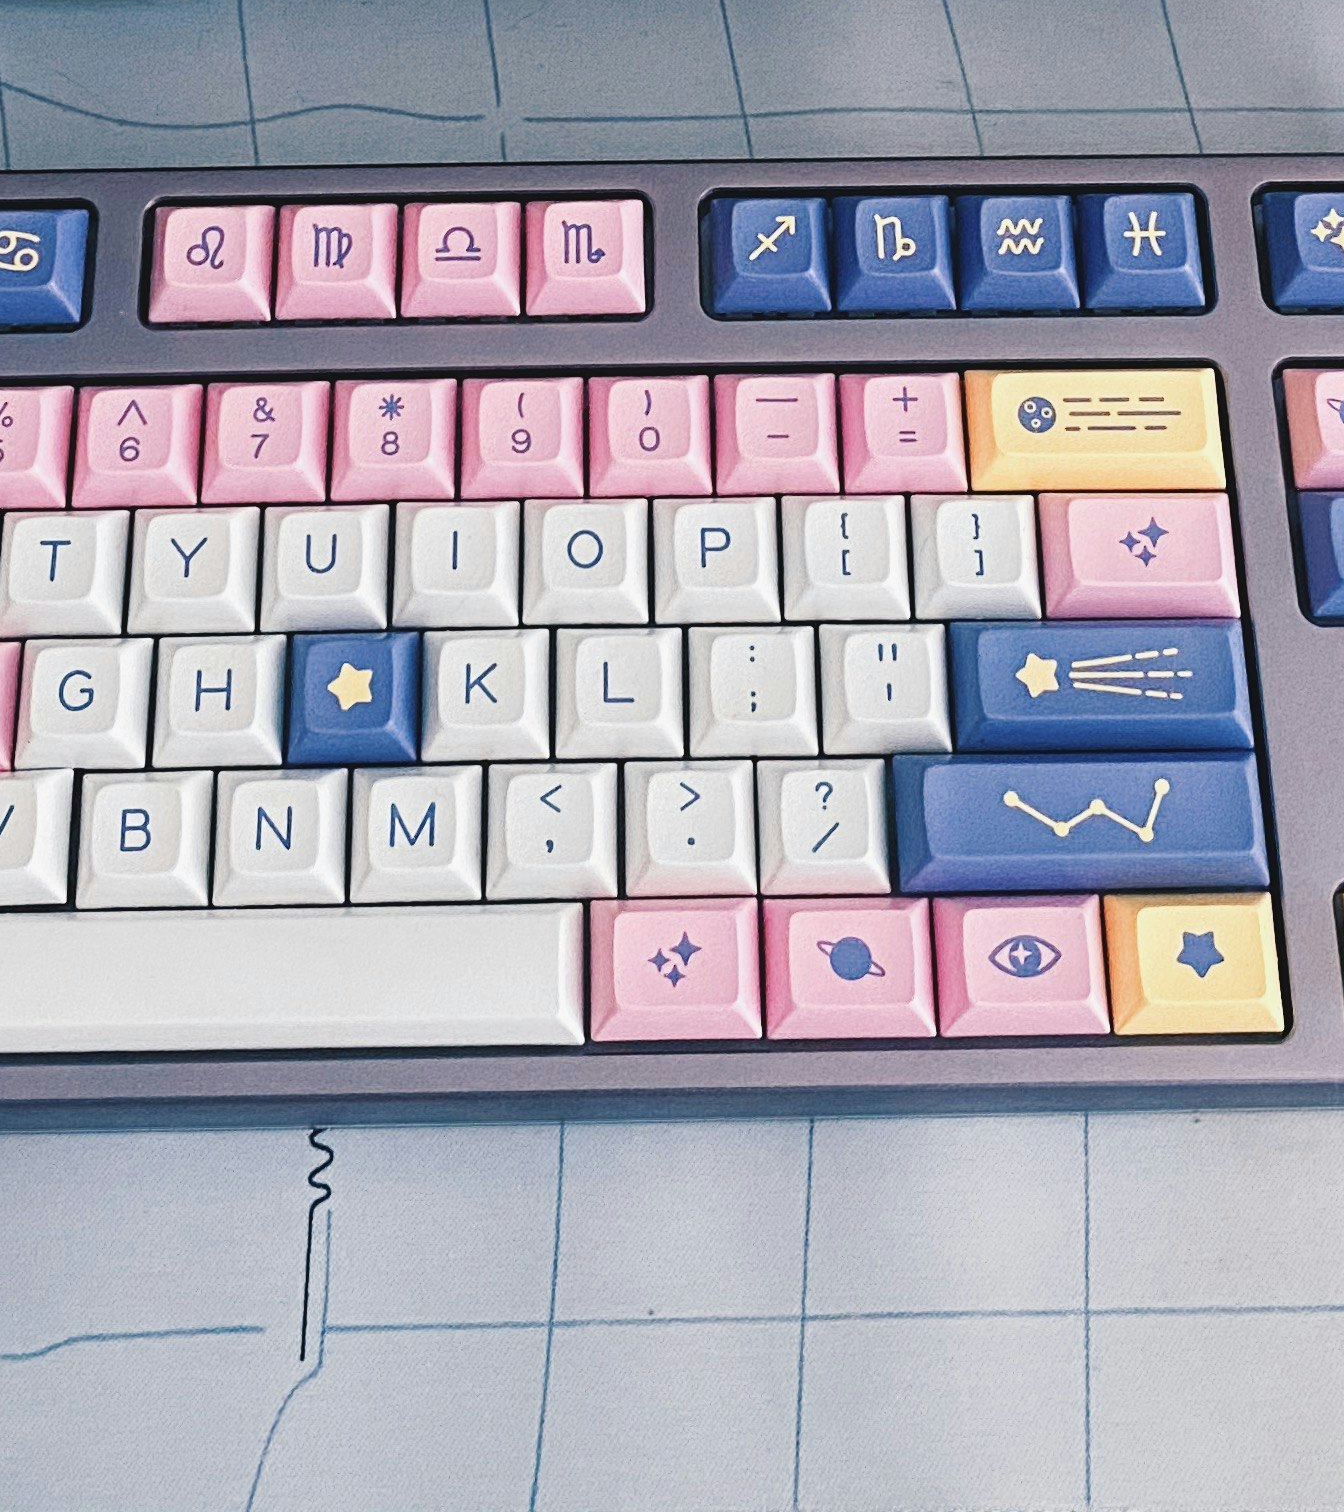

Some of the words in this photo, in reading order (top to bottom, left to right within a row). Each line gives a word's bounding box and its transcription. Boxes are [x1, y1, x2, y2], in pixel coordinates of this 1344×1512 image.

[119, 436, 141, 462] 6
[250, 433, 270, 460] 7
[380, 430, 400, 456] 8
[511, 428, 532, 454] 9
[638, 426, 661, 452] 0
[39, 539, 72, 583] T
[170, 537, 208, 578] Y
[305, 533, 338, 574] U
[452, 530, 458, 571] I
[566, 529, 604, 569] O
[700, 527, 731, 569] P
[58, 669, 95, 712] G
[194, 668, 232, 713] H
[464, 662, 498, 705] K
[602, 661, 635, 704] L
[119, 808, 152, 852] B
[255, 805, 293, 851] N
[389, 801, 436, 848] M
